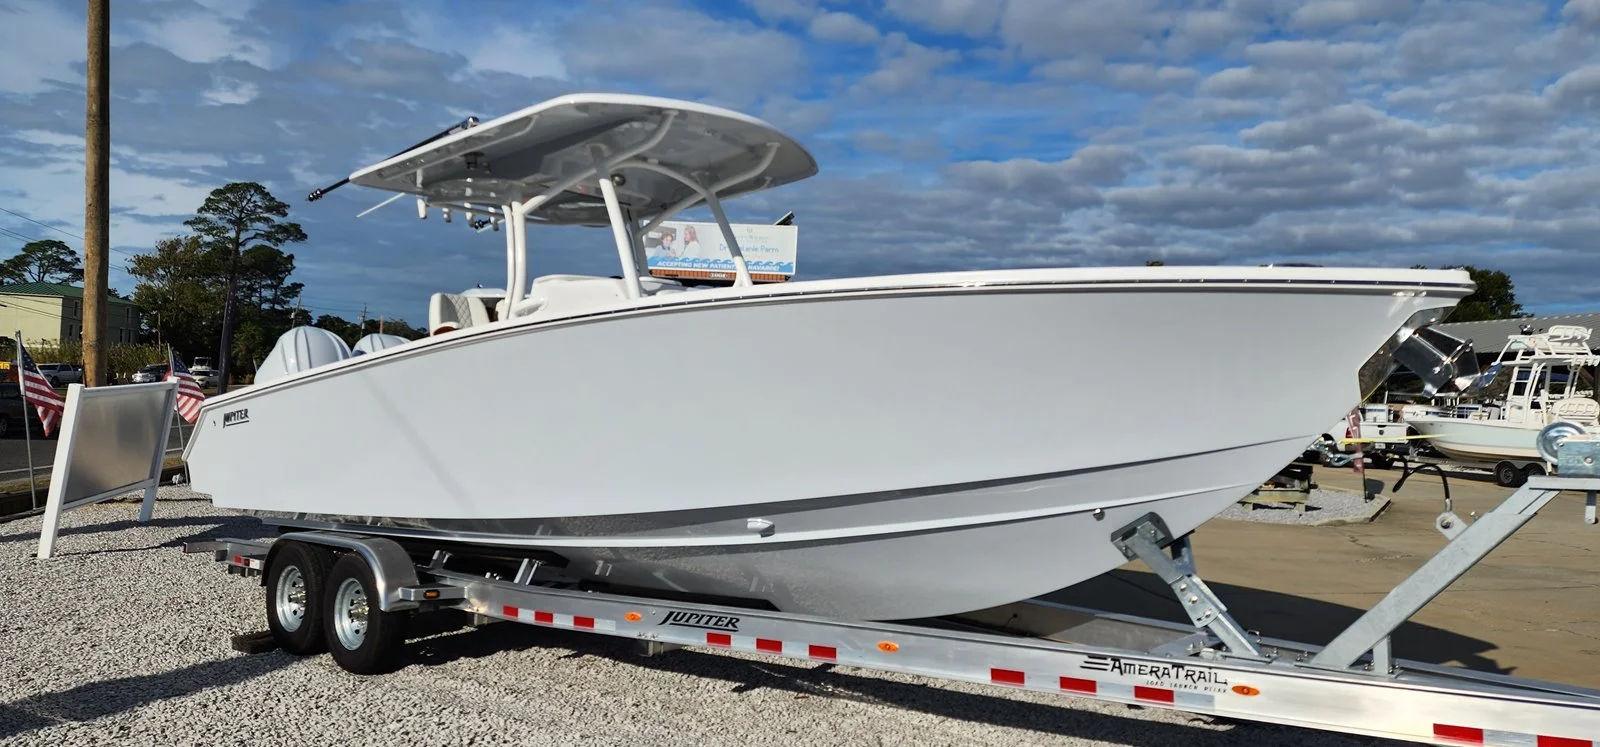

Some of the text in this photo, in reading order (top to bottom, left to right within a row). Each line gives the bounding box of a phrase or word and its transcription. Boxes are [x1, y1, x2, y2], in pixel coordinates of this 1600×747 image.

[656, 260, 692, 269] ACCEPTING
[693, 262, 709, 270] NEW
[709, 263, 736, 271] PATIENT
[223, 408, 249, 428] JUPITER
[658, 610, 740, 630] JUPITER
